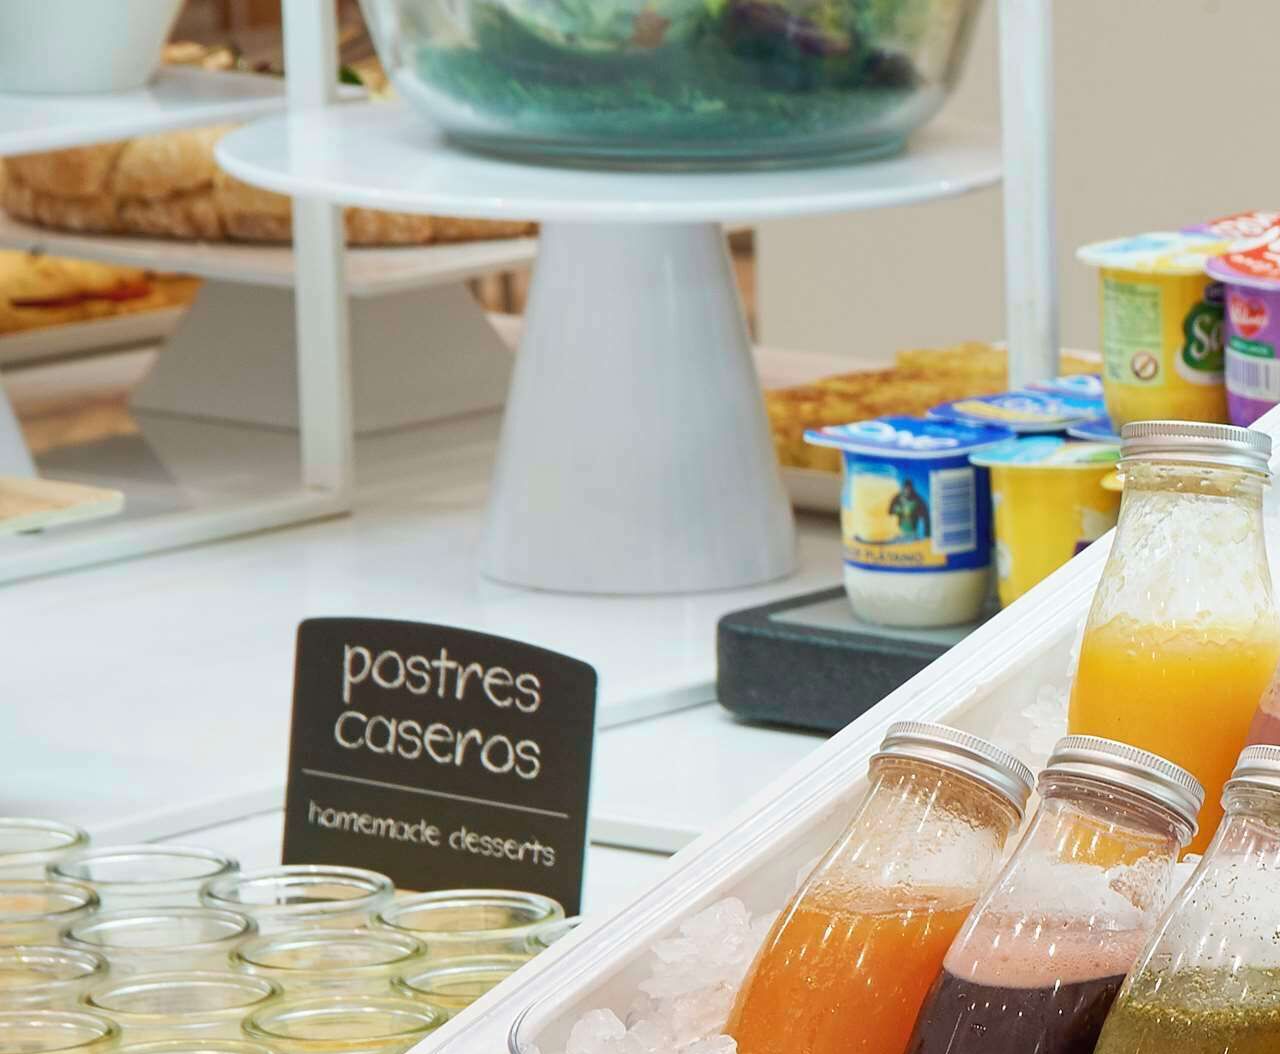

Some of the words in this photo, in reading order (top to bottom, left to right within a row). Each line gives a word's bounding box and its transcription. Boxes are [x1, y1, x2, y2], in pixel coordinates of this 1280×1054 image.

[342, 643, 541, 713] postres
[333, 710, 542, 780] caseros
[307, 799, 441, 847] homemade
[448, 826, 556, 867] desserts
